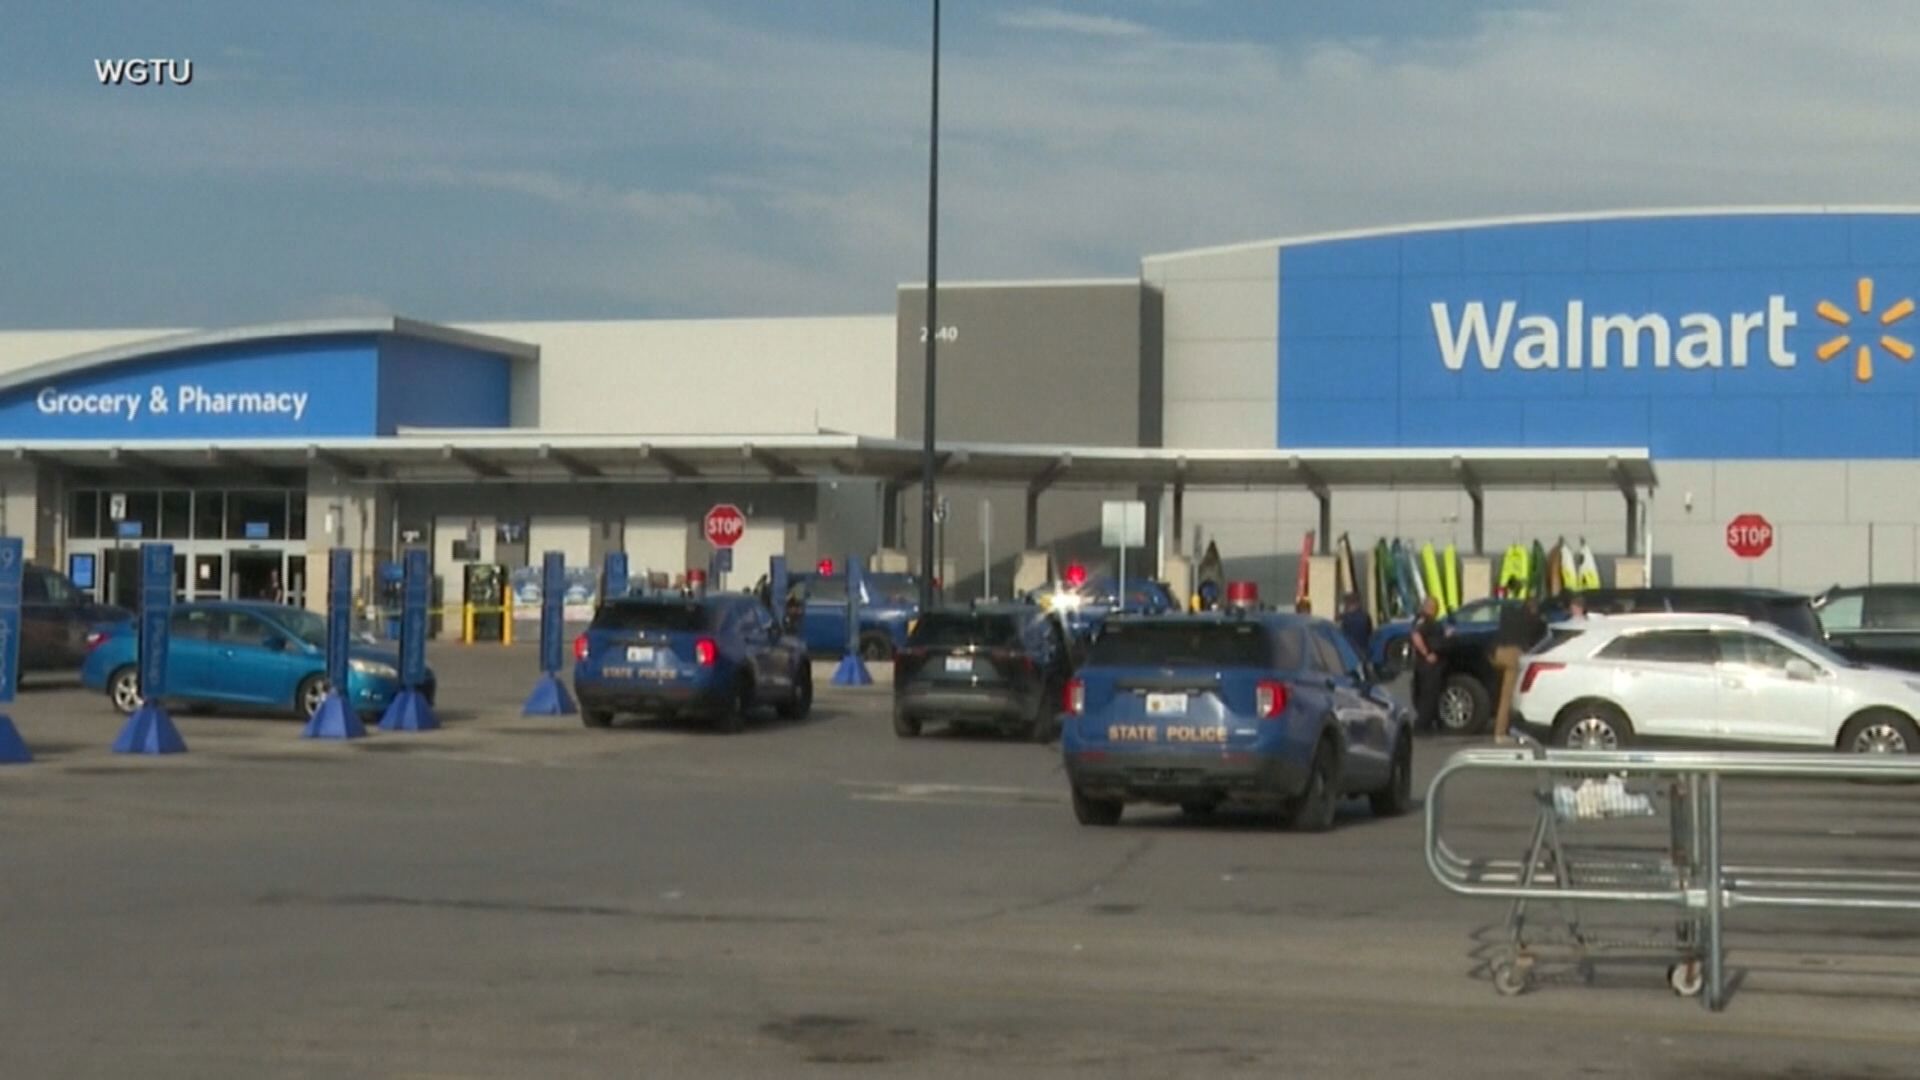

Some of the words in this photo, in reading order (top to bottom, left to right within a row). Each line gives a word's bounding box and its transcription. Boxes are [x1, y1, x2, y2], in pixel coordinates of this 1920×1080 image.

[920, 326, 958, 342] 240
[1430, 294, 1798, 370] Walmart
[37, 387, 142, 421] Grocery
[149, 385, 169, 414] &
[178, 384, 309, 421] Pharmacy
[708, 517, 743, 535] STOP
[1729, 525, 1771, 547] STOP
[1108, 725, 1158, 742] STATE
[1166, 725, 1228, 742] POLICE
